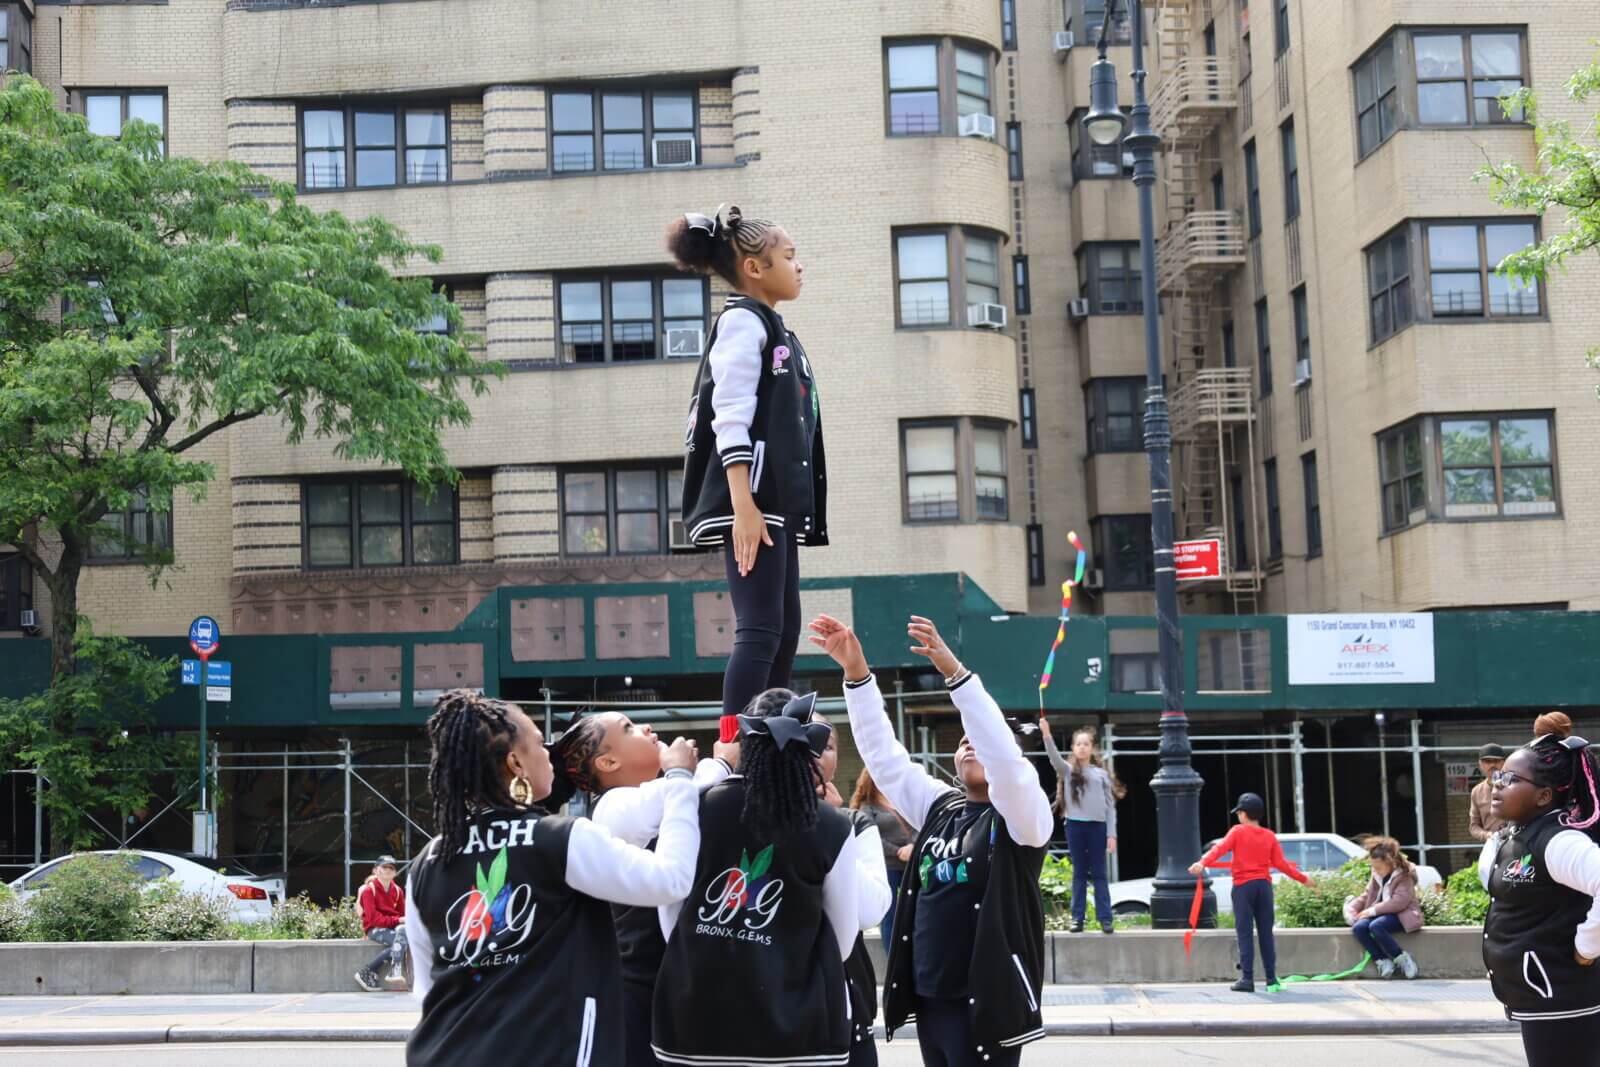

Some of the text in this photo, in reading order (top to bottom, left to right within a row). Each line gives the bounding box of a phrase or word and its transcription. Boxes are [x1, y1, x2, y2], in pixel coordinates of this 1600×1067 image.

[1322, 620, 1337, 630] Grand
[1342, 643, 1389, 653] APEX
[695, 923, 733, 938] BRONX
